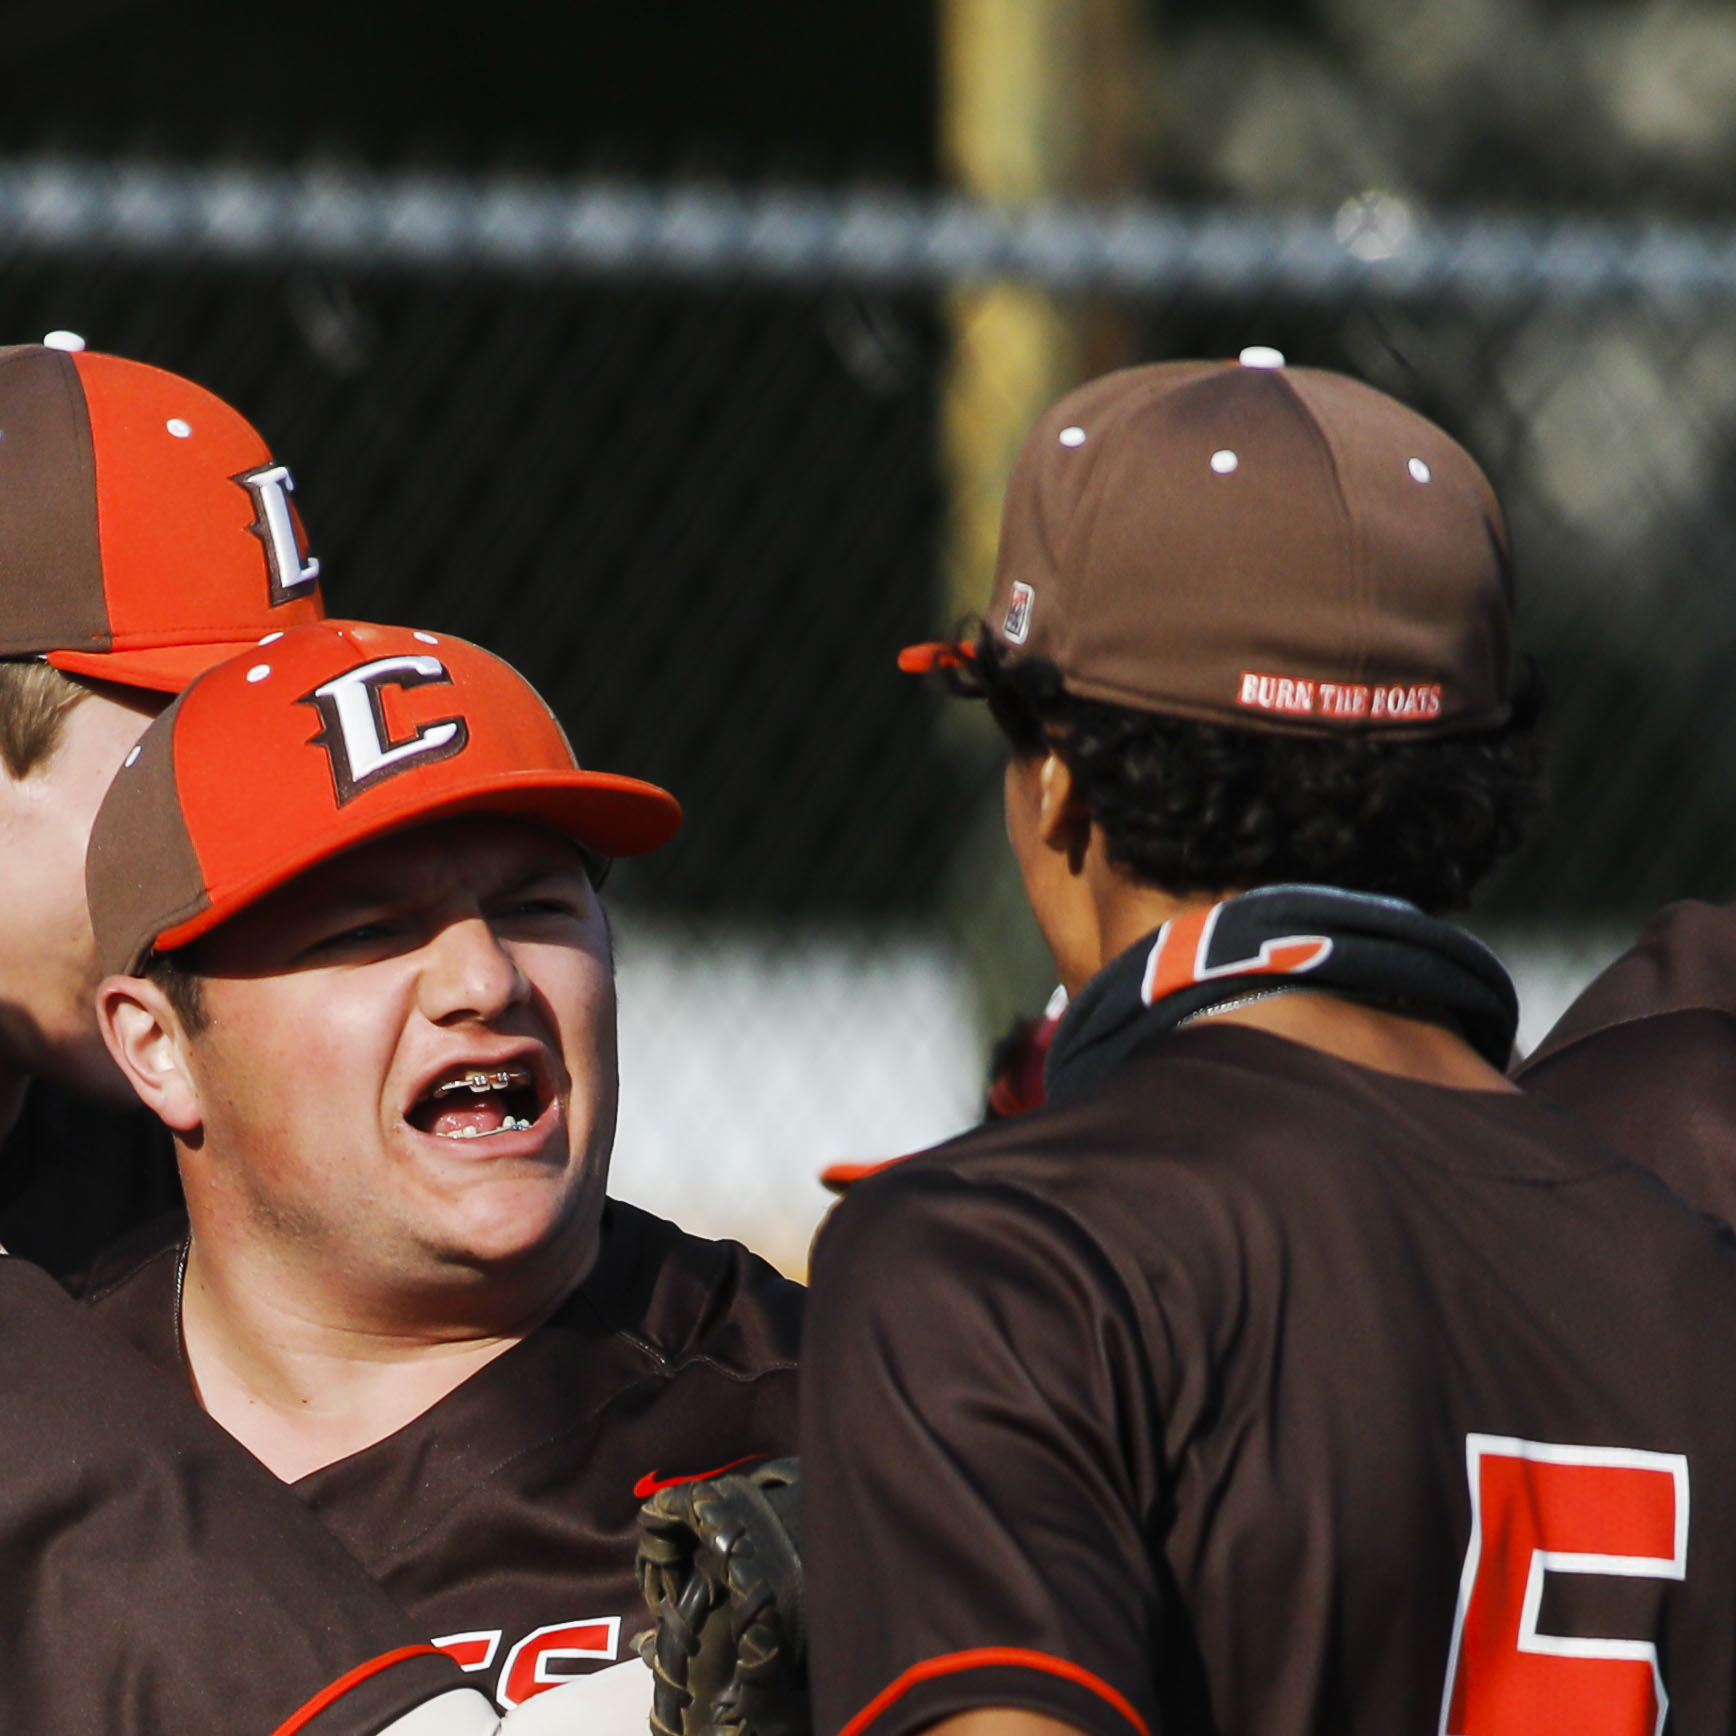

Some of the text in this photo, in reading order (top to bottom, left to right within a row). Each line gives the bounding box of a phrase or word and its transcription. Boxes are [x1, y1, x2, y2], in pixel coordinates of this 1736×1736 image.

[292, 655, 468, 808] C
[1241, 672, 1441, 715] BURN THE BOATS
